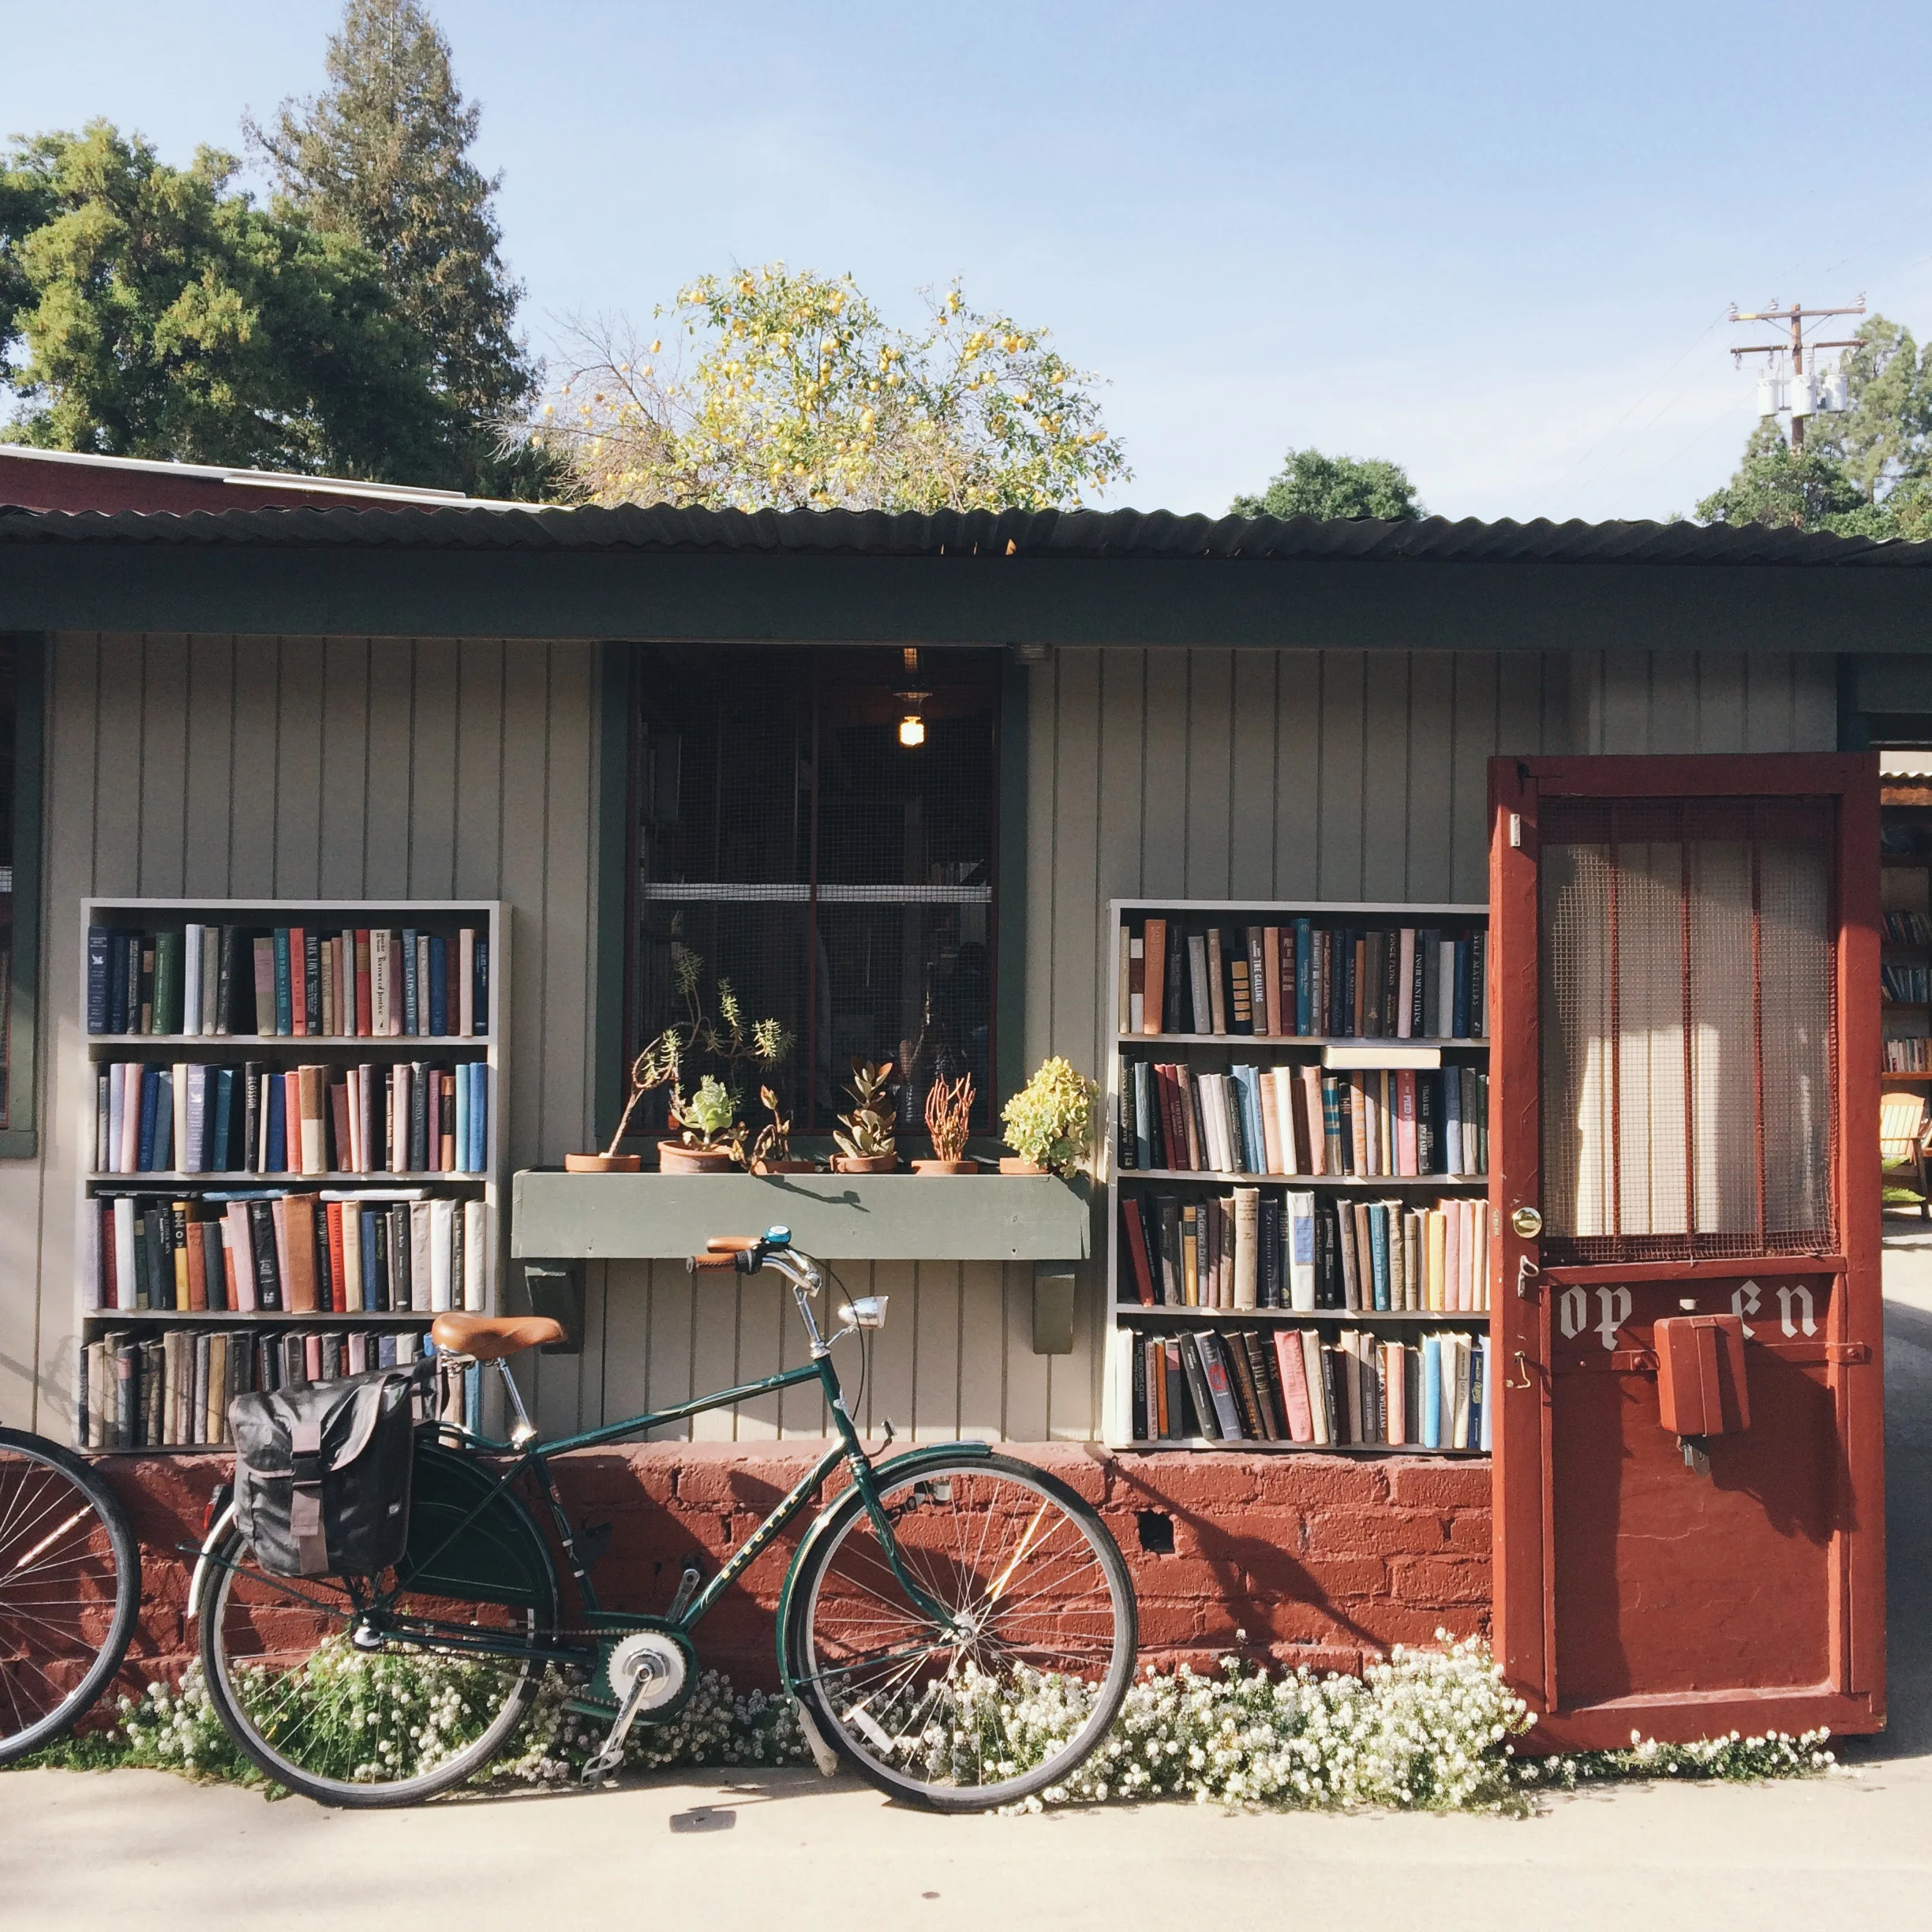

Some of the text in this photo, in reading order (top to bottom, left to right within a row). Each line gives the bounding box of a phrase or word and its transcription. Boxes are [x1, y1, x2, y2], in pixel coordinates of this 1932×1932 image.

[307, 937, 317, 955] DARK
[306, 958, 318, 975] LOVE
[406, 968, 414, 990] LADY
[1254, 974, 1263, 1002] CALLING
[248, 1076, 257, 1109] BLOSSOM
[721, 1495, 799, 1579] ELECTRA
